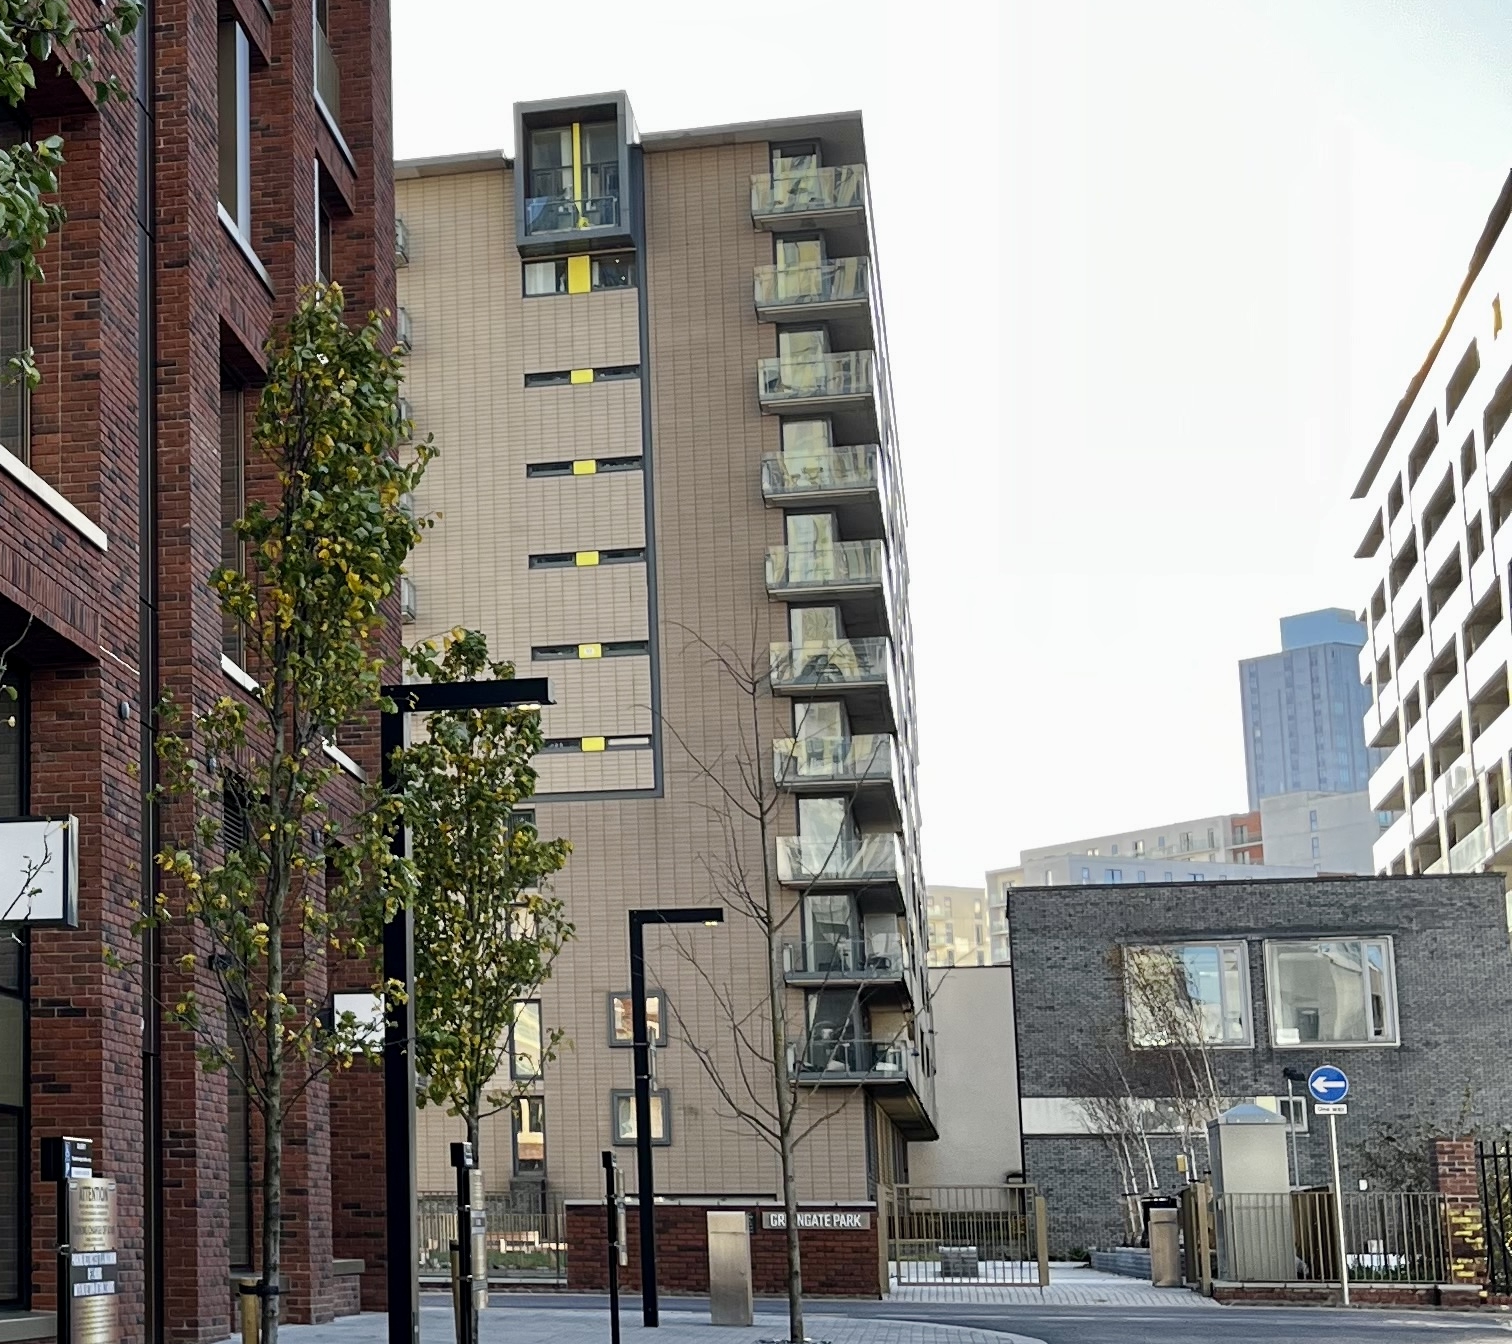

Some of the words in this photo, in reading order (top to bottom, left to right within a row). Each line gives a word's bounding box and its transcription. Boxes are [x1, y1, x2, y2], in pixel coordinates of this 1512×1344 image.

[79, 1186, 109, 1202] ATTENTION
[769, 1213, 832, 1227] GRNGATE
[832, 1213, 862, 1227] PARK
